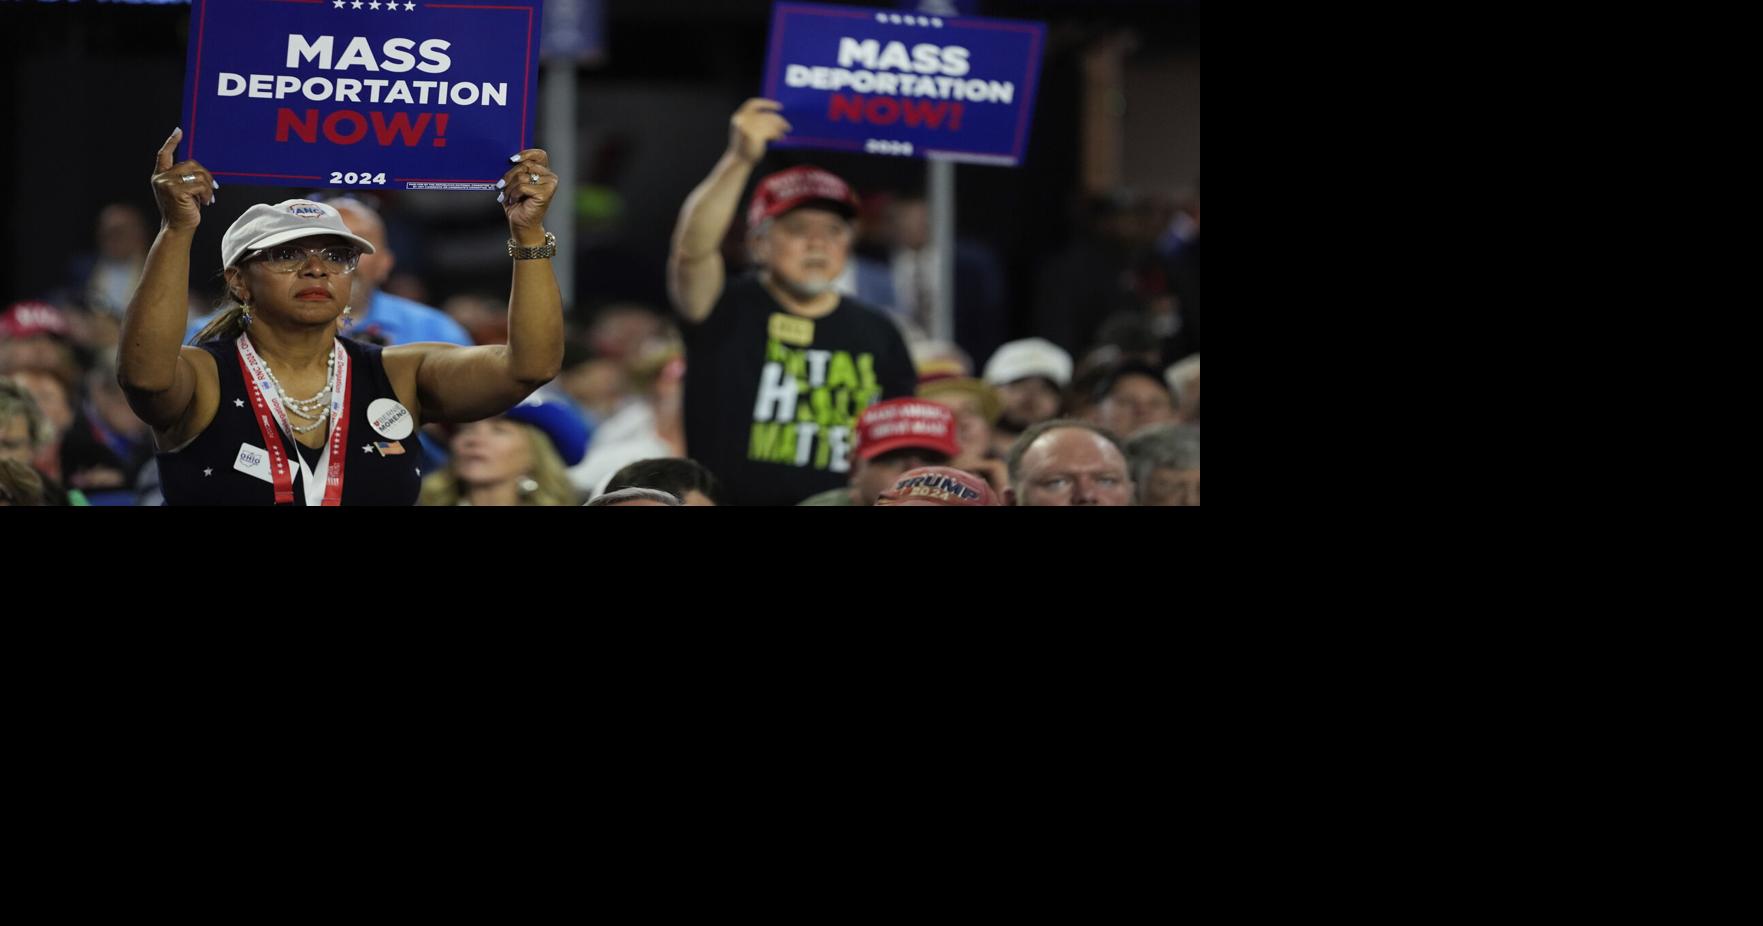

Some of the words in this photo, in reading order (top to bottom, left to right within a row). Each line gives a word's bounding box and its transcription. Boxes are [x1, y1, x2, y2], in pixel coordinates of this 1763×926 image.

[286, 34, 451, 73] MASS
[838, 37, 970, 76] MASS
[217, 72, 508, 106] DEPORTATION
[785, 65, 1014, 104] DEPORTATION
[275, 107, 449, 147] NOW!
[829, 94, 965, 131] NOW!
[329, 171, 387, 185] 2024
[379, 409, 407, 432] MORENO
[241, 453, 261, 464] OHIO
[896, 474, 980, 501] TRUMP
[911, 486, 950, 500] 2024
